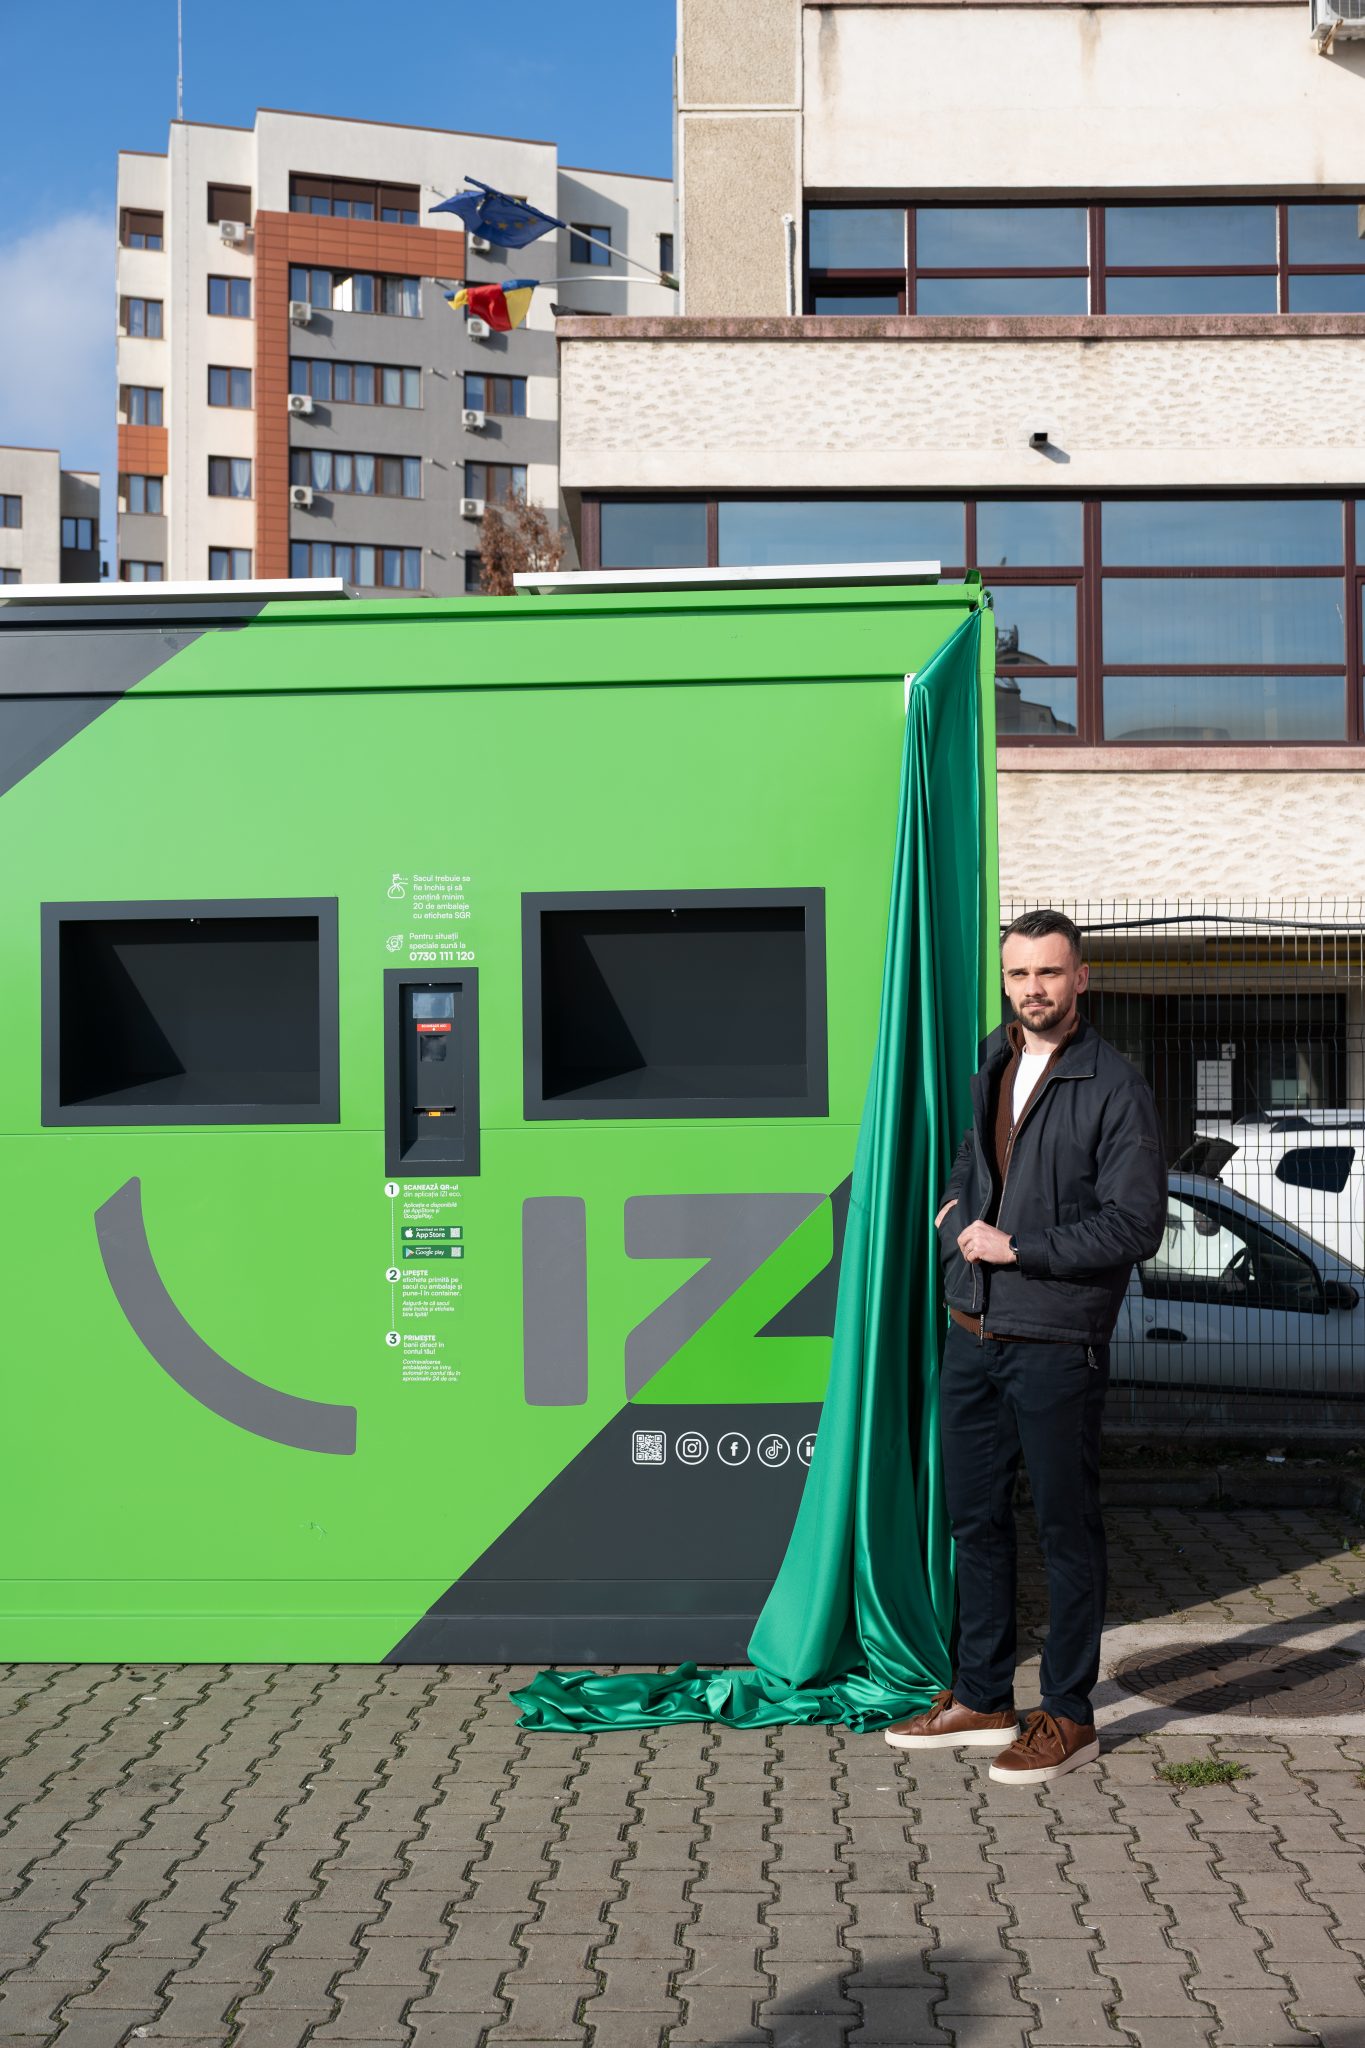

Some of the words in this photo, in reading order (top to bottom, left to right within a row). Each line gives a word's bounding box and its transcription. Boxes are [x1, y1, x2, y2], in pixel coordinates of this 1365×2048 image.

[414, 874, 434, 882] Sacul
[436, 874, 461, 882] trebuie
[414, 902, 424, 910] 20
[426, 902, 435, 910] de
[437, 902, 469, 911] ambalaje
[455, 911, 471, 919] SGR
[410, 942, 438, 950] speciale
[410, 952, 437, 961] 0730
[440, 952, 453, 961] 111
[457, 952, 475, 961] 120
[390, 1270, 398, 1280] 2
[390, 1334, 397, 1344] 3
